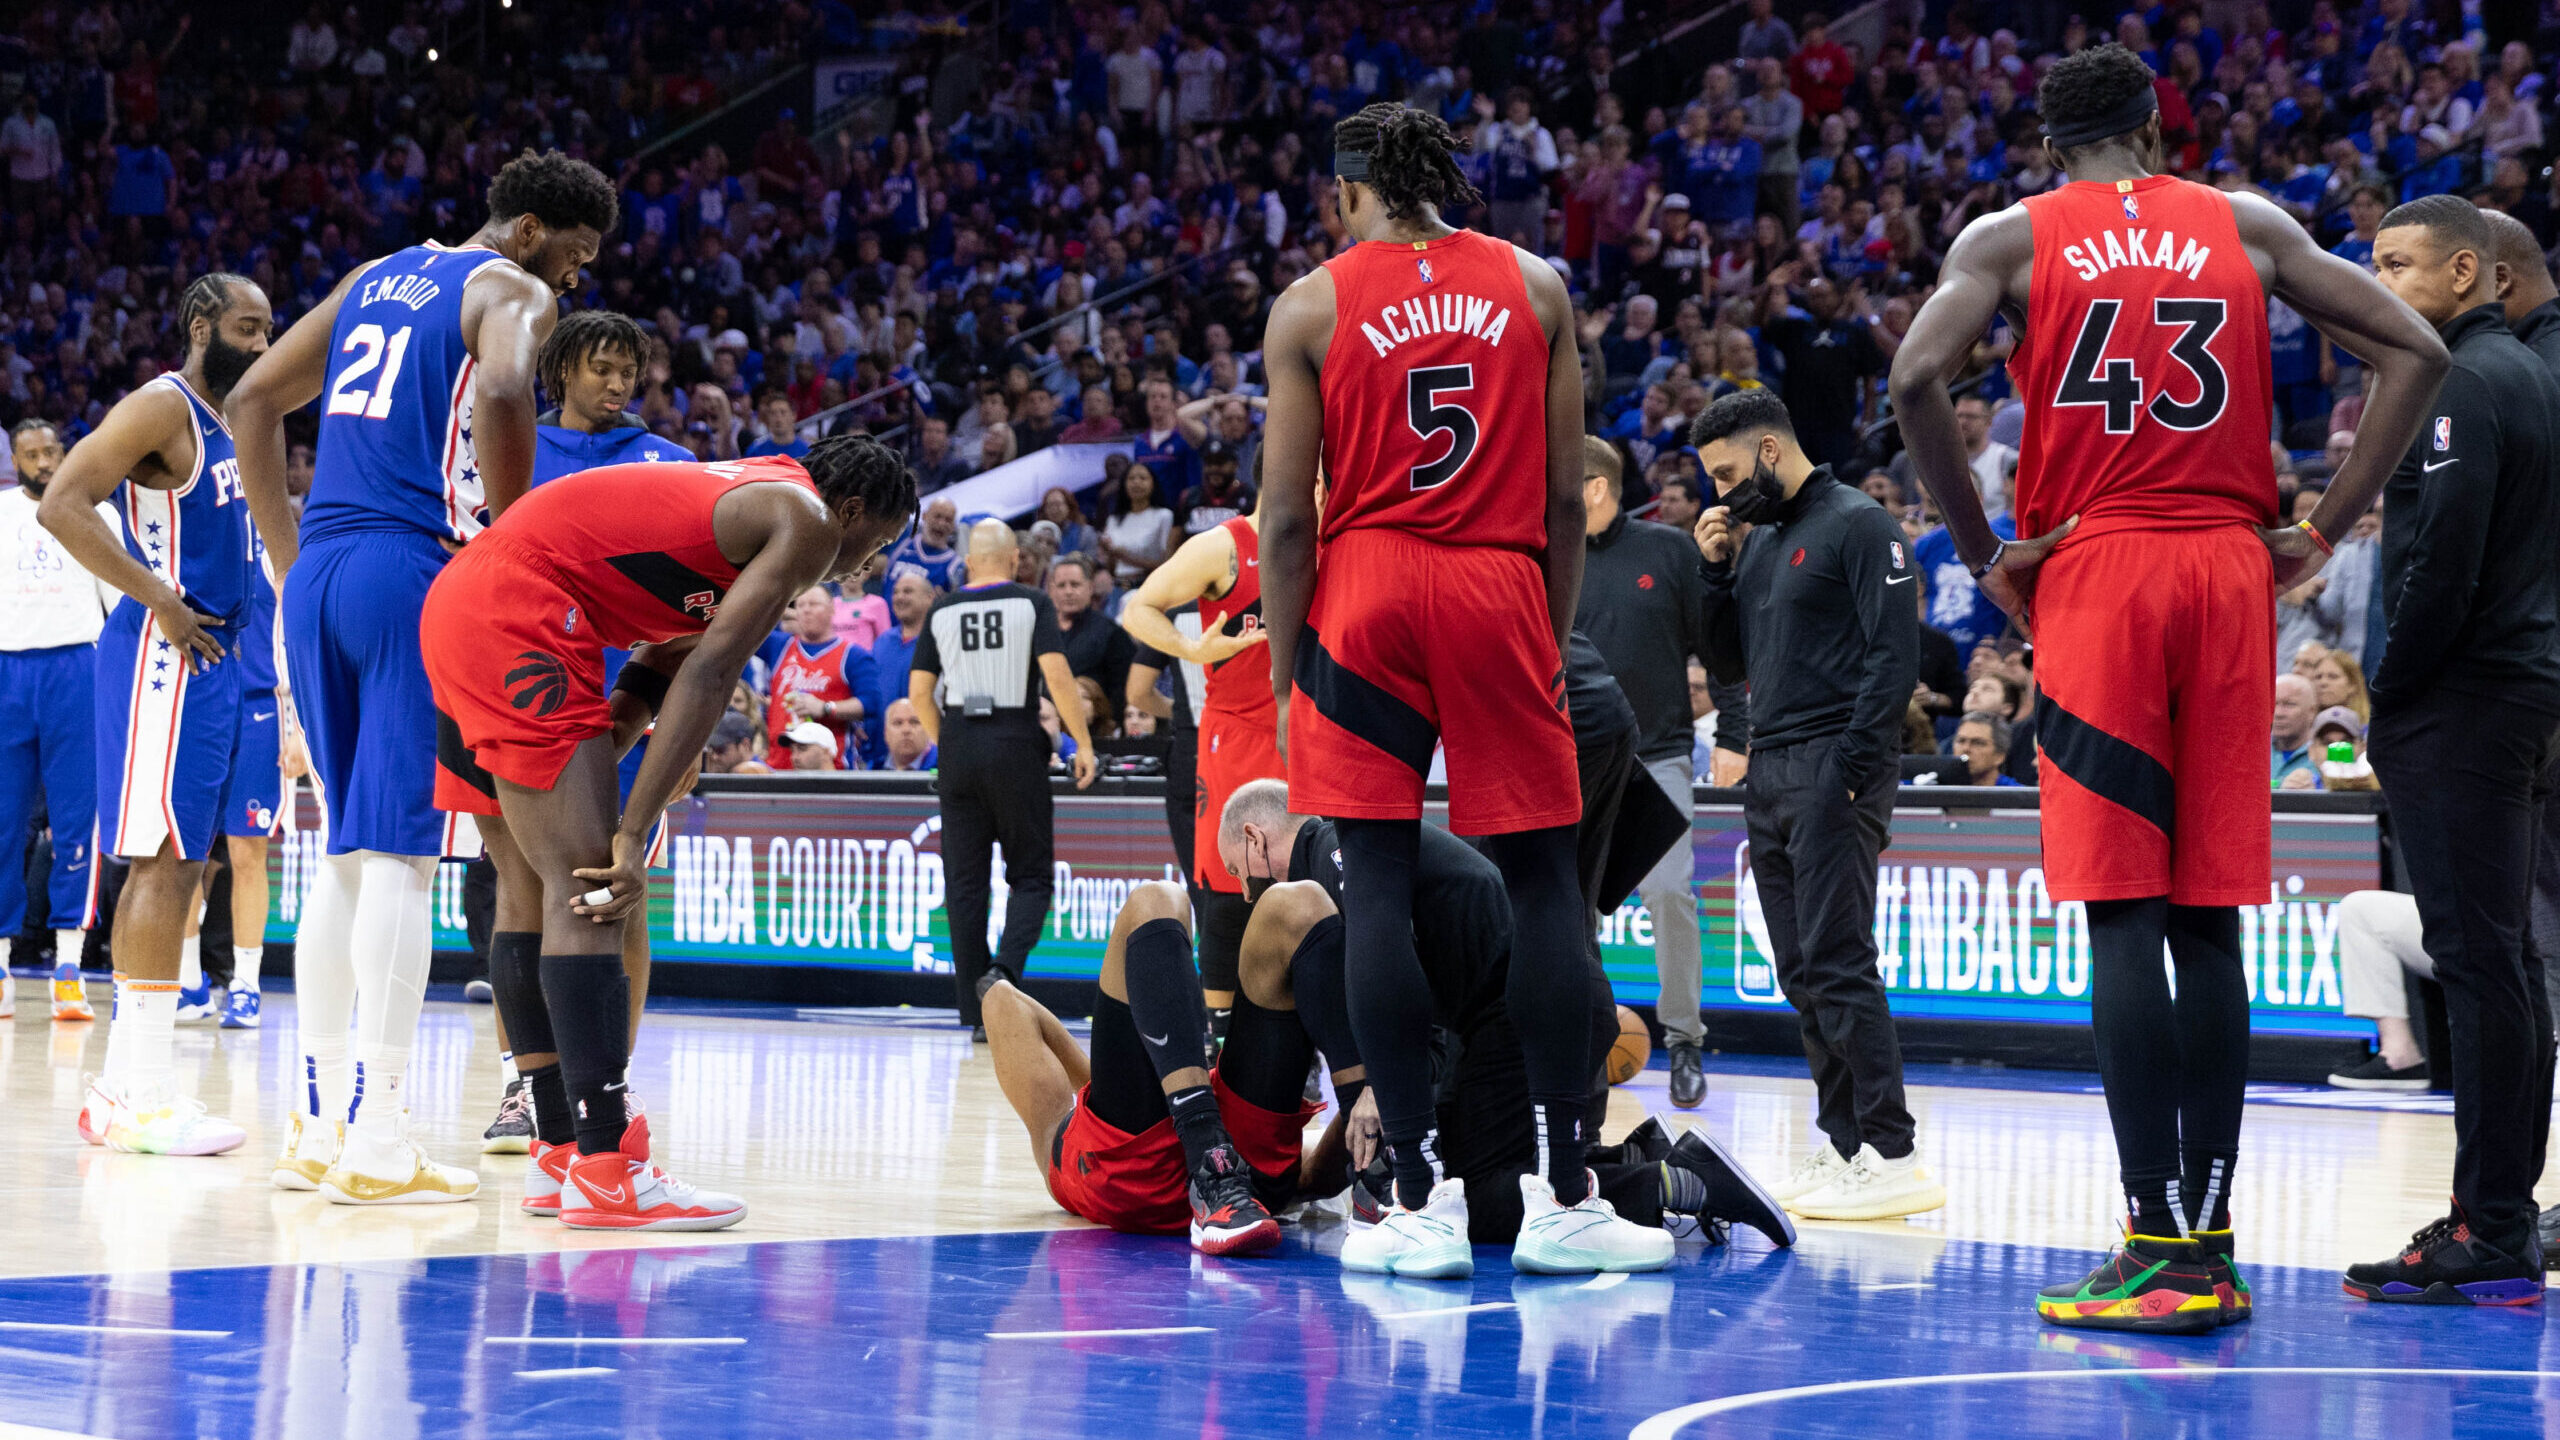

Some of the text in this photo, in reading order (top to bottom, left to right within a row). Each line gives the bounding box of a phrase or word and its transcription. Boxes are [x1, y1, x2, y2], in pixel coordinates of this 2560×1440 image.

[2063, 227, 2211, 281] SIAKAM
[360, 274, 440, 311] EMBIID
[1360, 293, 1511, 358] ACHIUWA
[326, 323, 412, 420] 21
[2052, 297, 2229, 434] 43
[1407, 362, 1480, 492] 5
[210, 457, 246, 508] PH
[960, 610, 1004, 651] 68
[672, 834, 757, 945] NBA
